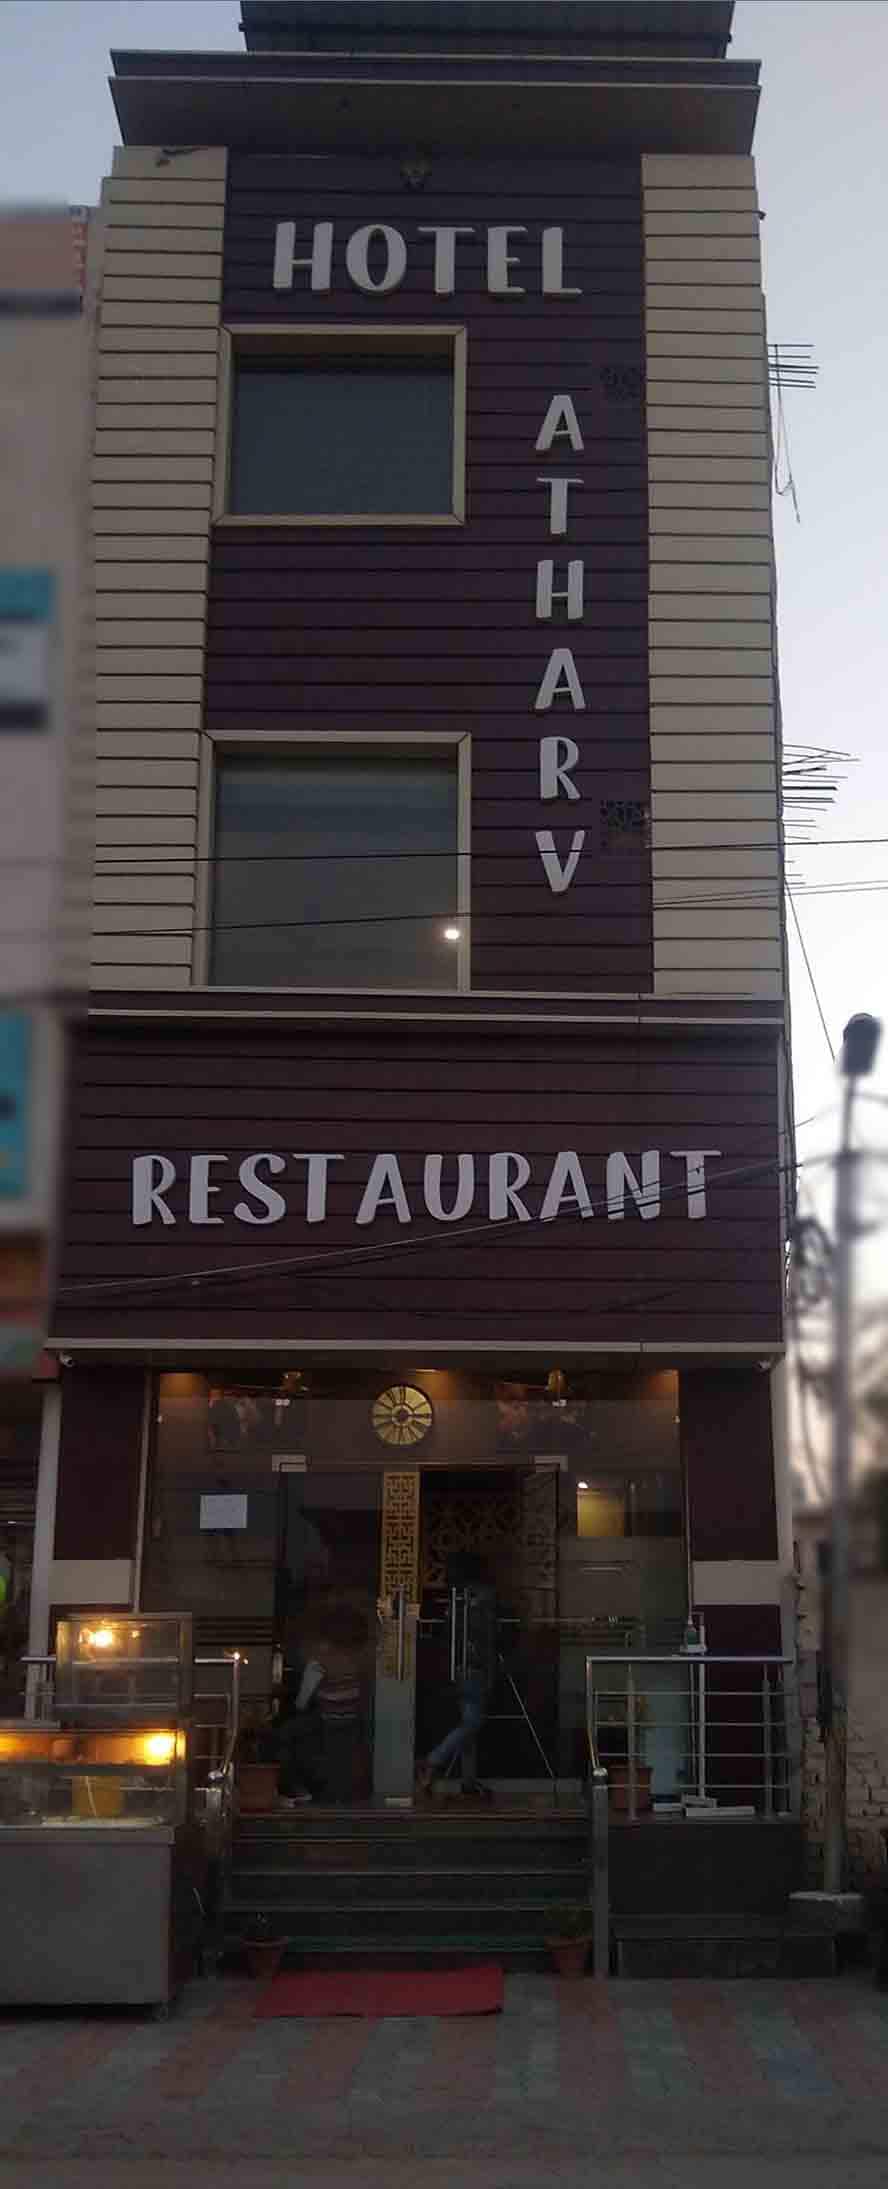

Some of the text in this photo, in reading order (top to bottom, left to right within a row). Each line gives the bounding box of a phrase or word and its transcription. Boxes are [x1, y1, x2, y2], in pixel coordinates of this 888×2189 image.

[272, 221, 583, 294] HOTEL
[535, 394, 585, 892] ATHARV
[132, 1150, 721, 1224] RESTAURANT
